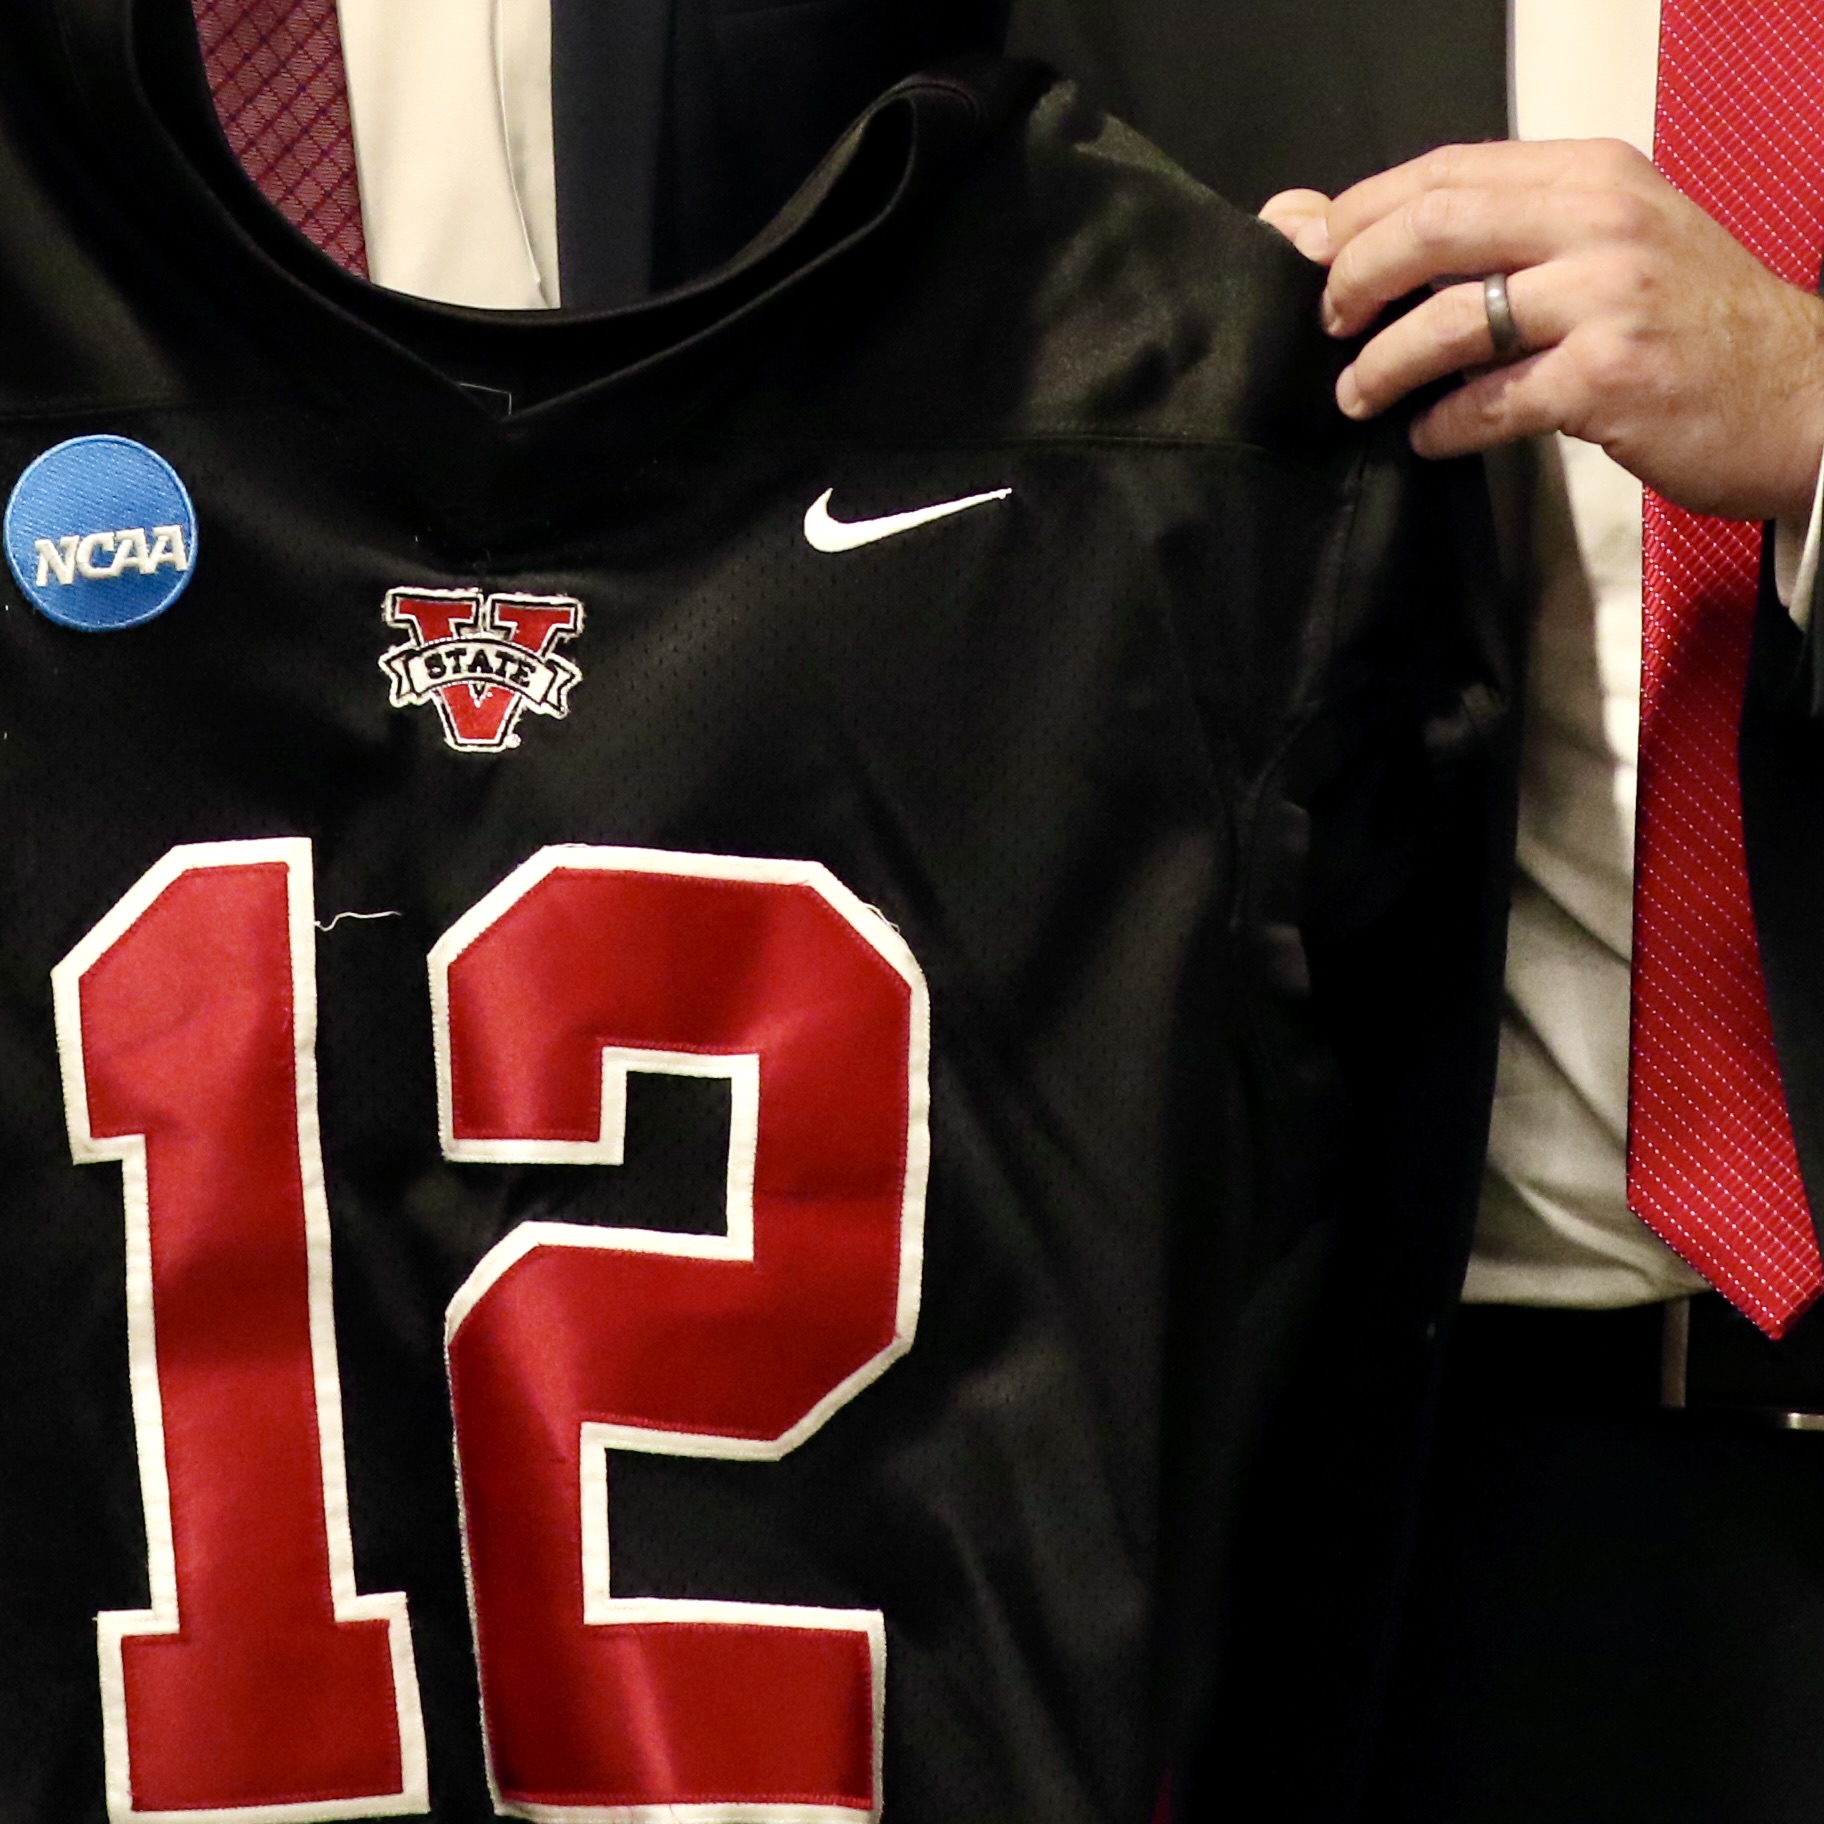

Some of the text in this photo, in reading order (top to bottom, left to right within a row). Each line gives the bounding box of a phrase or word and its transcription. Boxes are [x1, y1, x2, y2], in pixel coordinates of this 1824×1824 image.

[34, 524, 189, 588] NCAA
[425, 646, 537, 689] STATE
[51, 835, 931, 1824] 12
